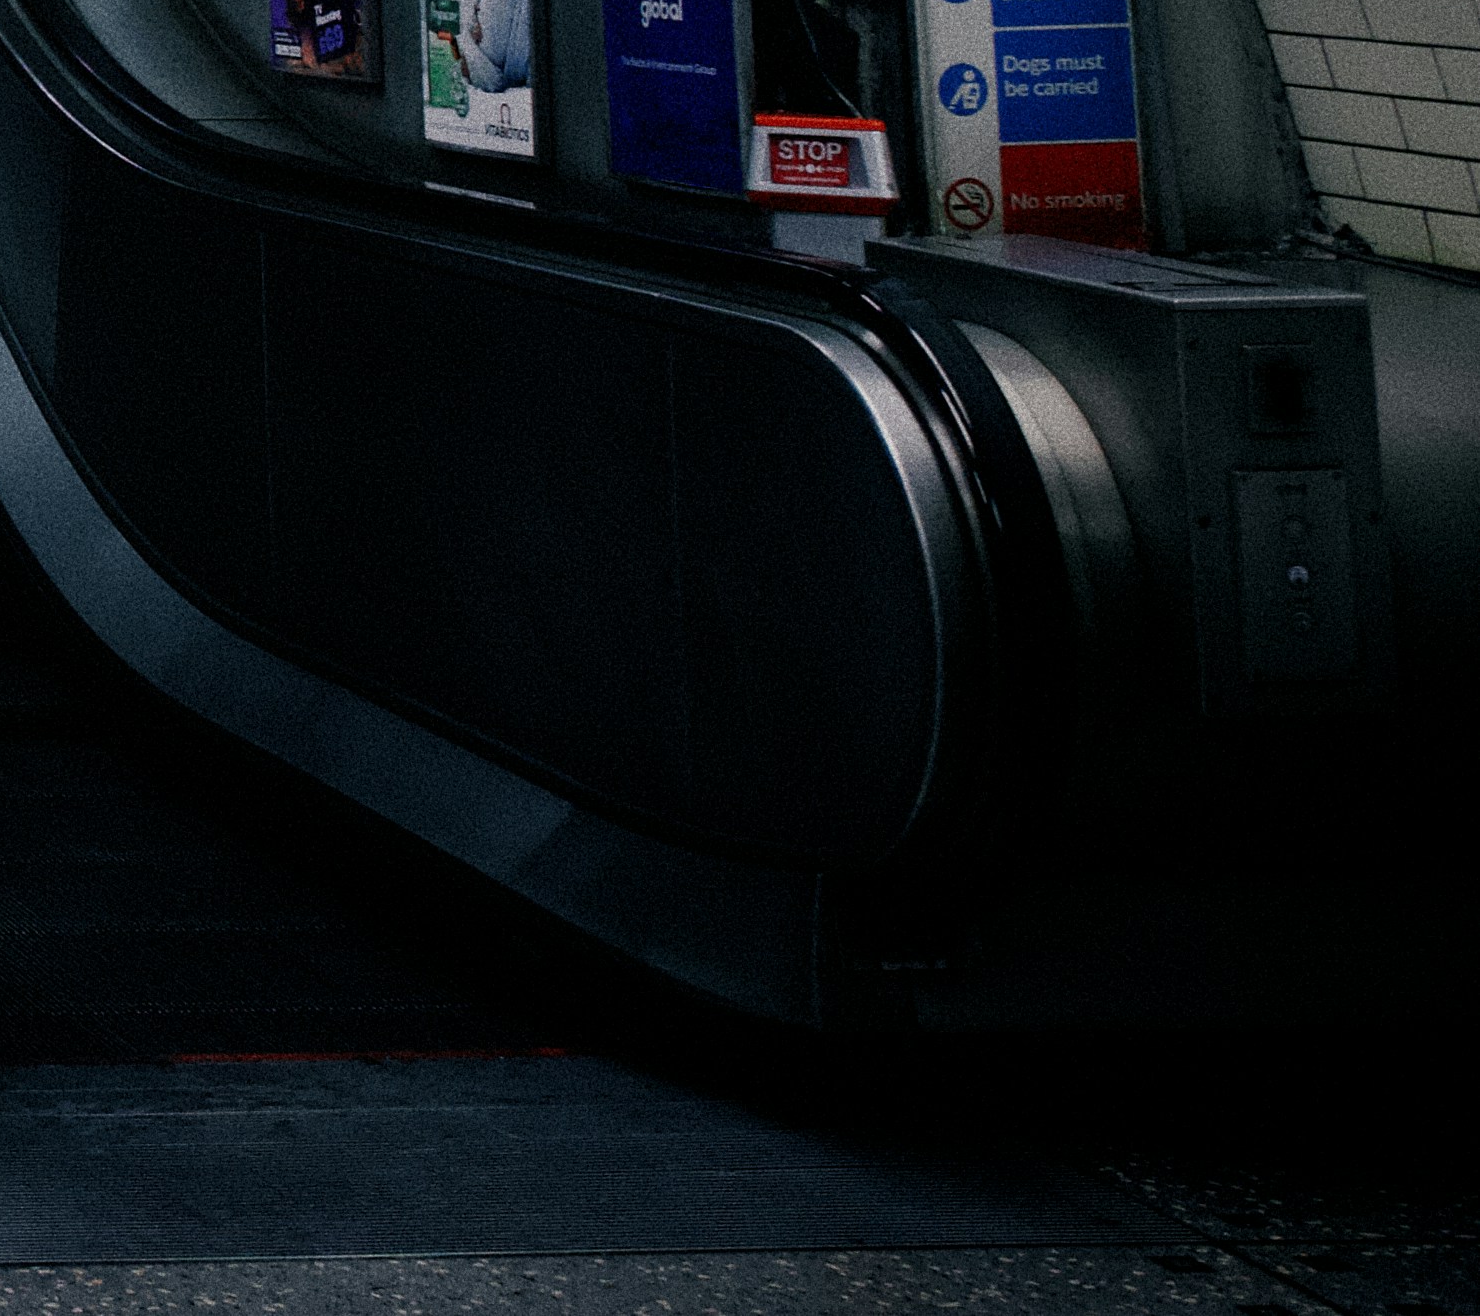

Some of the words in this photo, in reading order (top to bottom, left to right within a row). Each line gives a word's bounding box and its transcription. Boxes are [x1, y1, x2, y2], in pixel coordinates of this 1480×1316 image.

[1003, 54, 1051, 76] Dogs
[1055, 54, 1105, 71] must
[1004, 79, 1029, 97] be
[1033, 77, 1099, 97] carried
[778, 138, 843, 161] STOP
[1010, 192, 1040, 210] No
[1044, 192, 1126, 212] smoking
